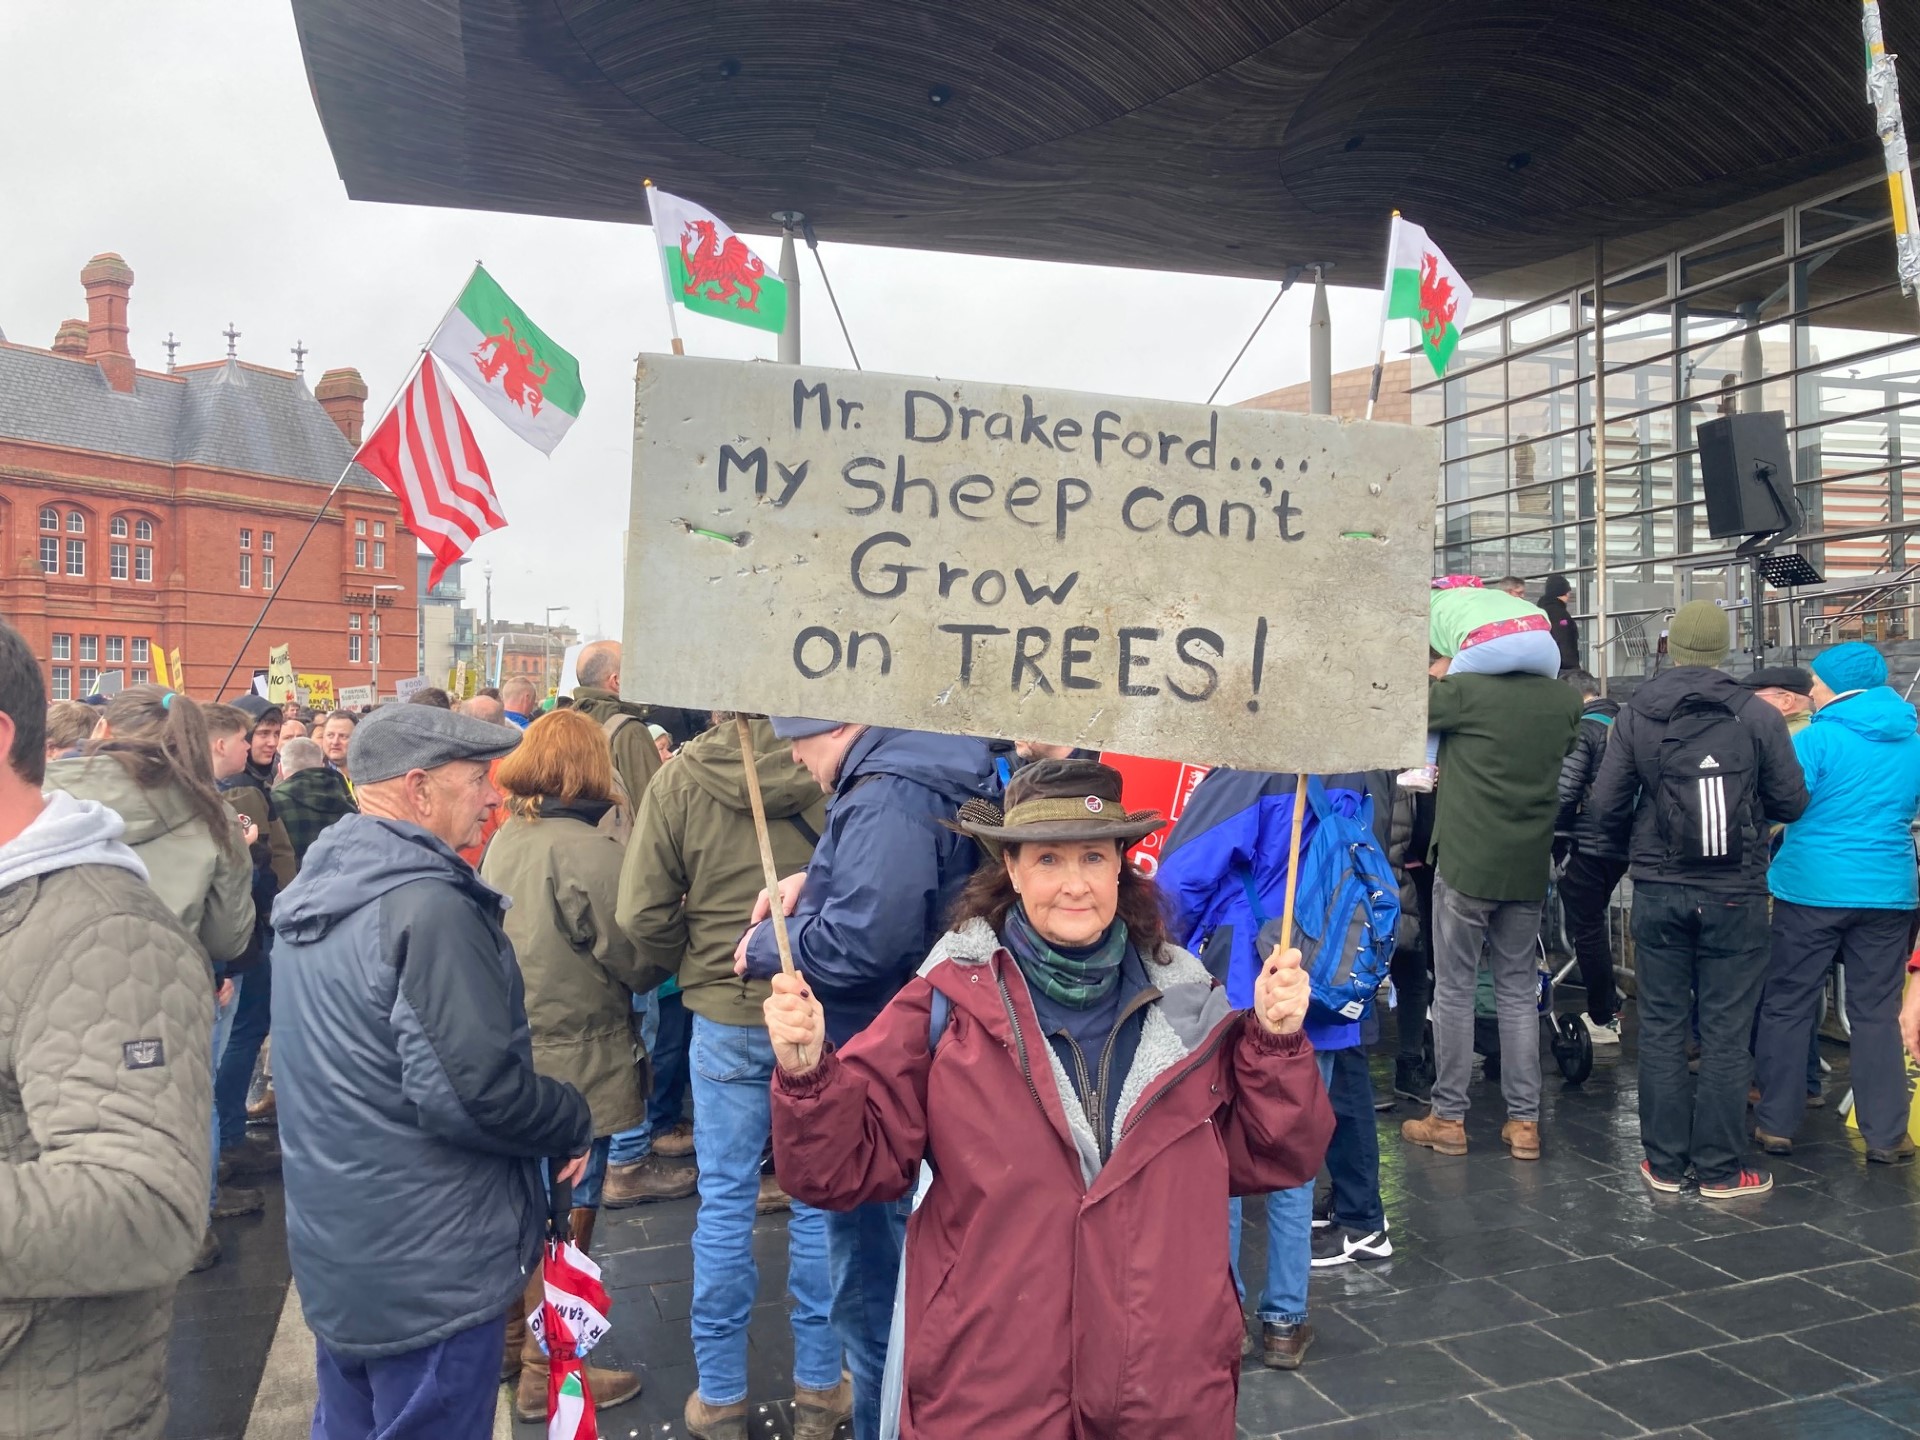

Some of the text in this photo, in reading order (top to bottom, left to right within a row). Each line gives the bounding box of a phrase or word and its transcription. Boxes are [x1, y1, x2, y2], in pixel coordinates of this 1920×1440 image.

[793, 378, 864, 432] Mr.
[718, 444, 1307, 543] My Sheep can't
[850, 531, 1081, 606] Grow
[793, 616, 1267, 713] on TREES!
